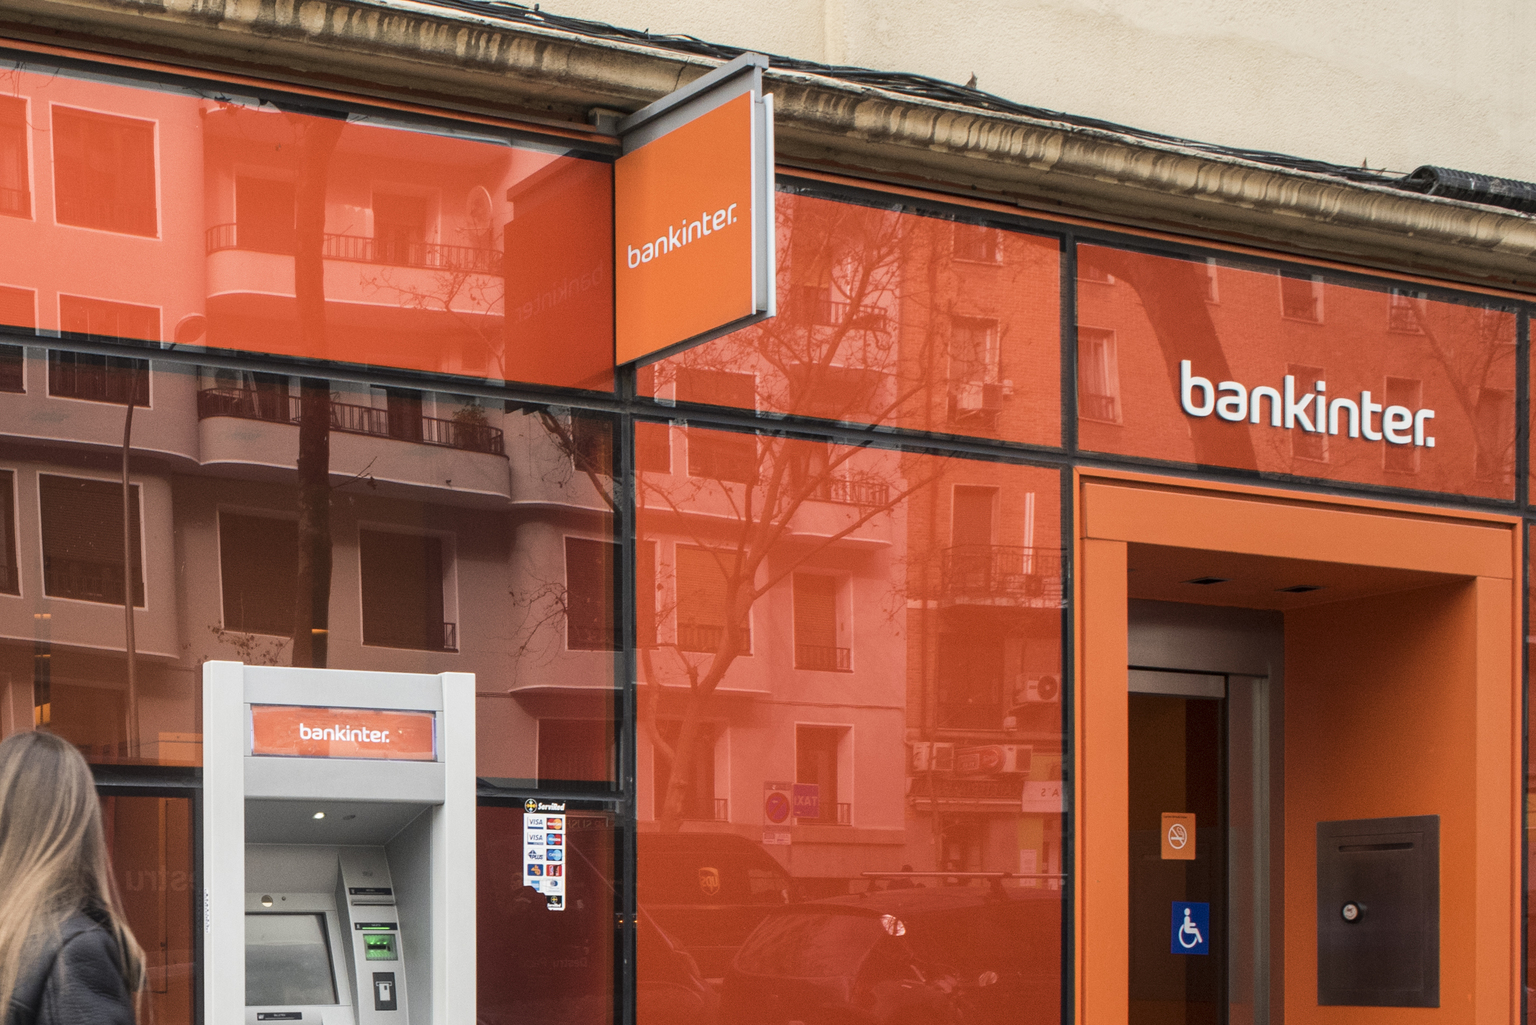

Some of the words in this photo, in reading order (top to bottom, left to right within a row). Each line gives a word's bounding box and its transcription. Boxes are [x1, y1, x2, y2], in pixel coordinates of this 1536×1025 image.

[628, 203, 737, 268] bankinter.
[1181, 360, 1435, 448] bankinter.
[299, 723, 390, 744] bankinter.
